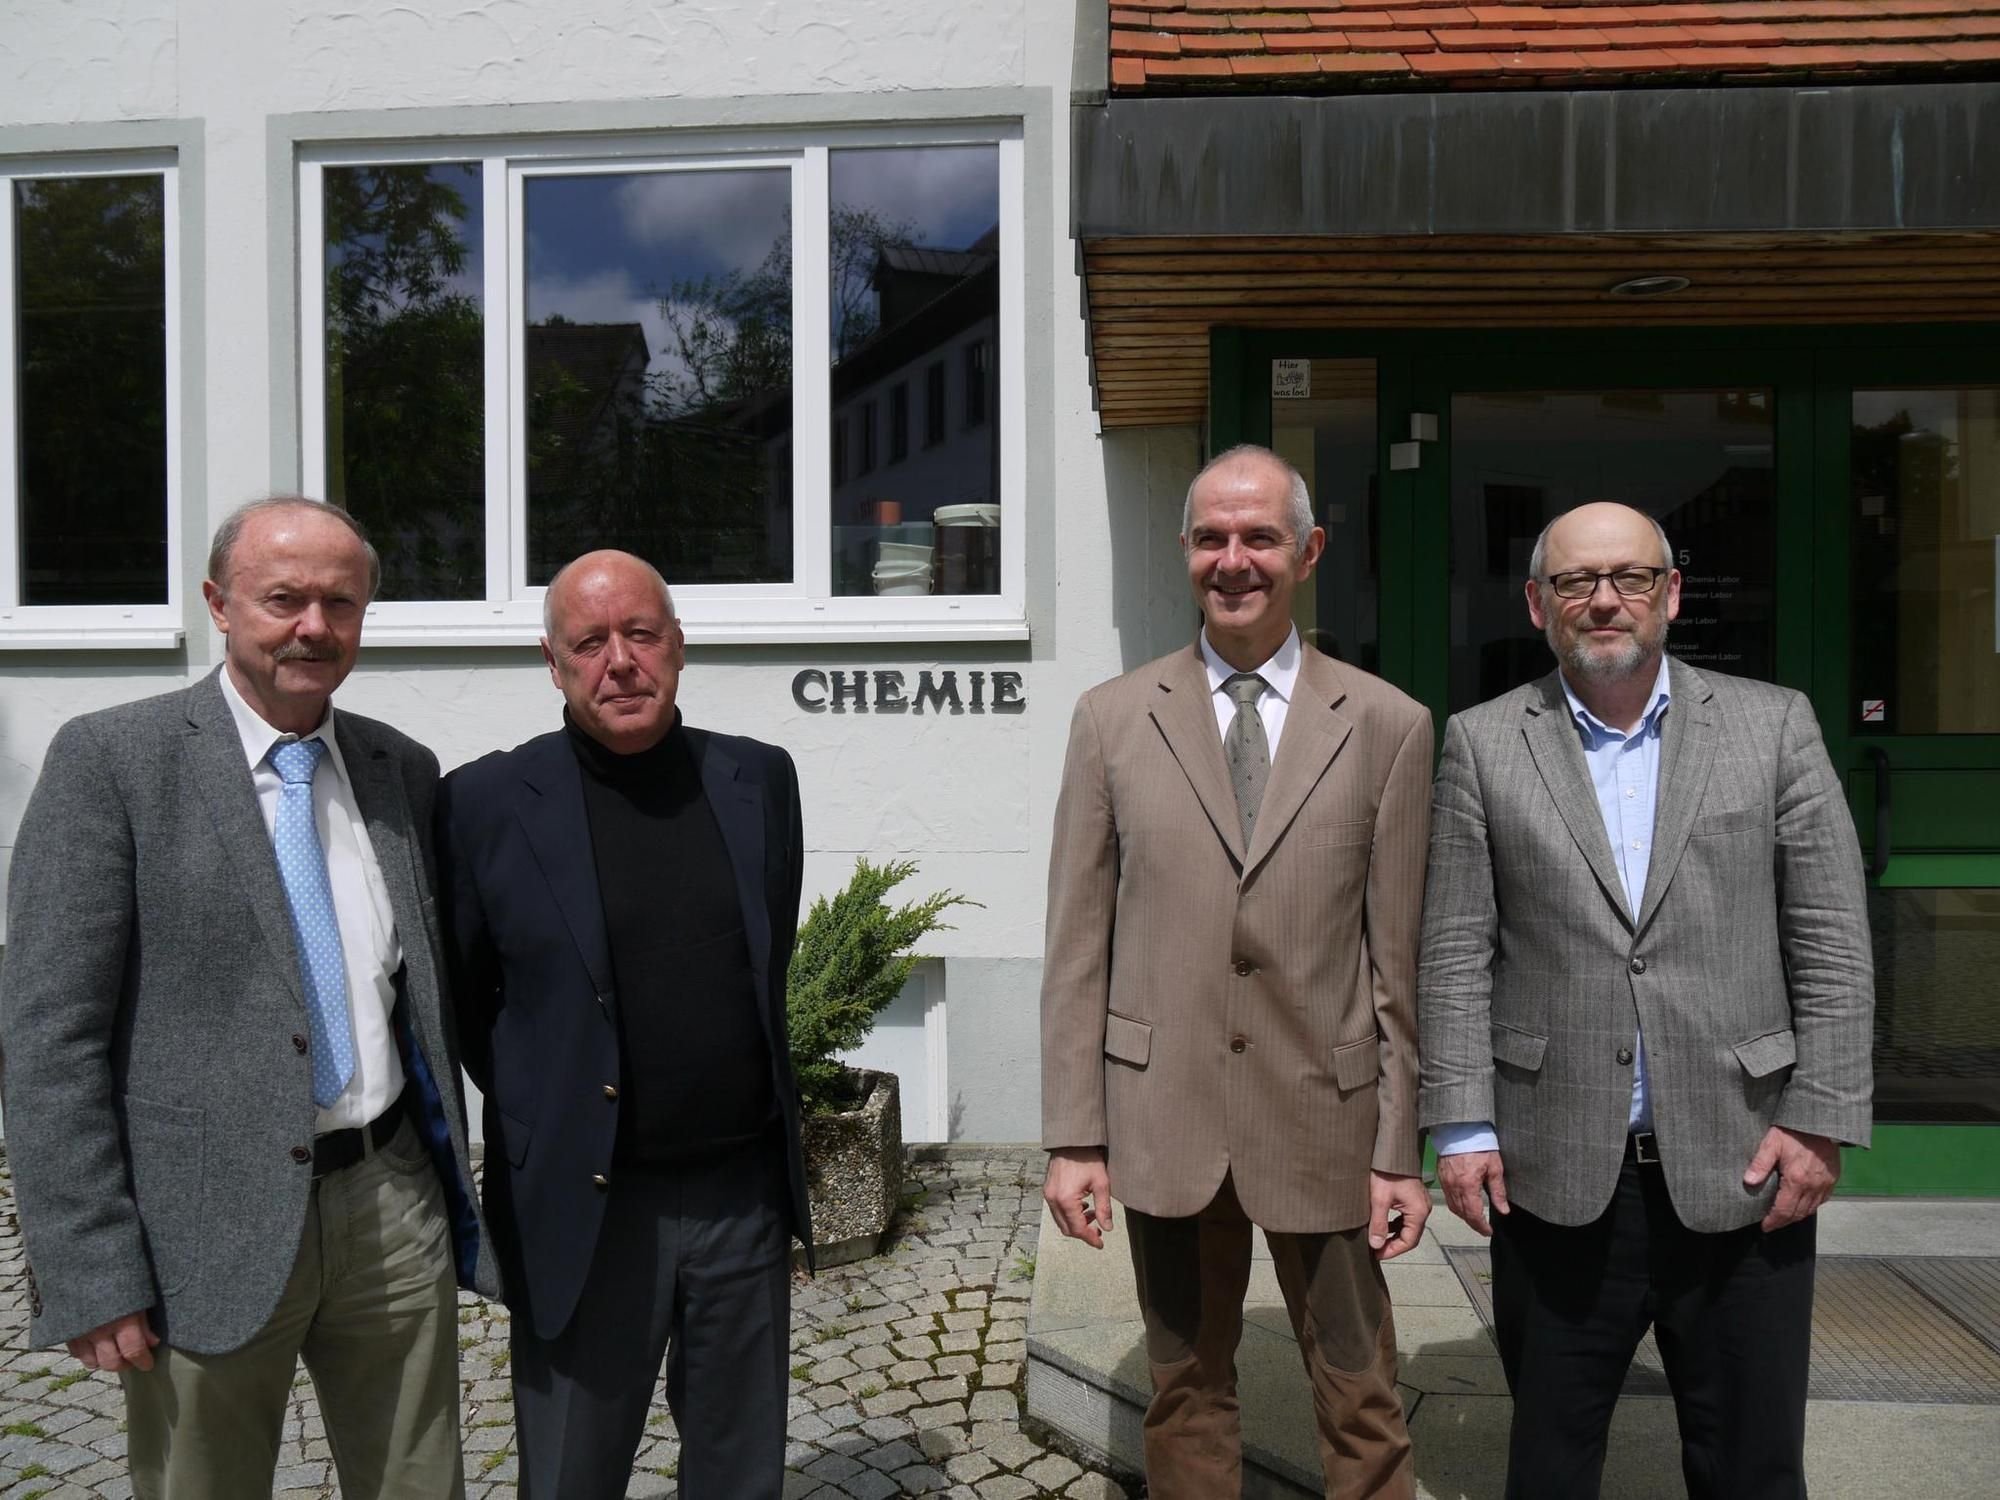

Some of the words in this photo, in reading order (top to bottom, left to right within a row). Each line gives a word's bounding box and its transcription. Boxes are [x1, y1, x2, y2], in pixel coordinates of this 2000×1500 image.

[1279, 360, 1298, 369] Hier
[1679, 549, 1690, 565] 5
[1679, 592, 1708, 600] genieur
[1710, 591, 1733, 599] Labor
[1670, 617, 1693, 626] ologie
[1695, 617, 1718, 625] Labor
[1719, 652, 1742, 660] Labor
[791, 668, 1026, 711] CHEMIE
